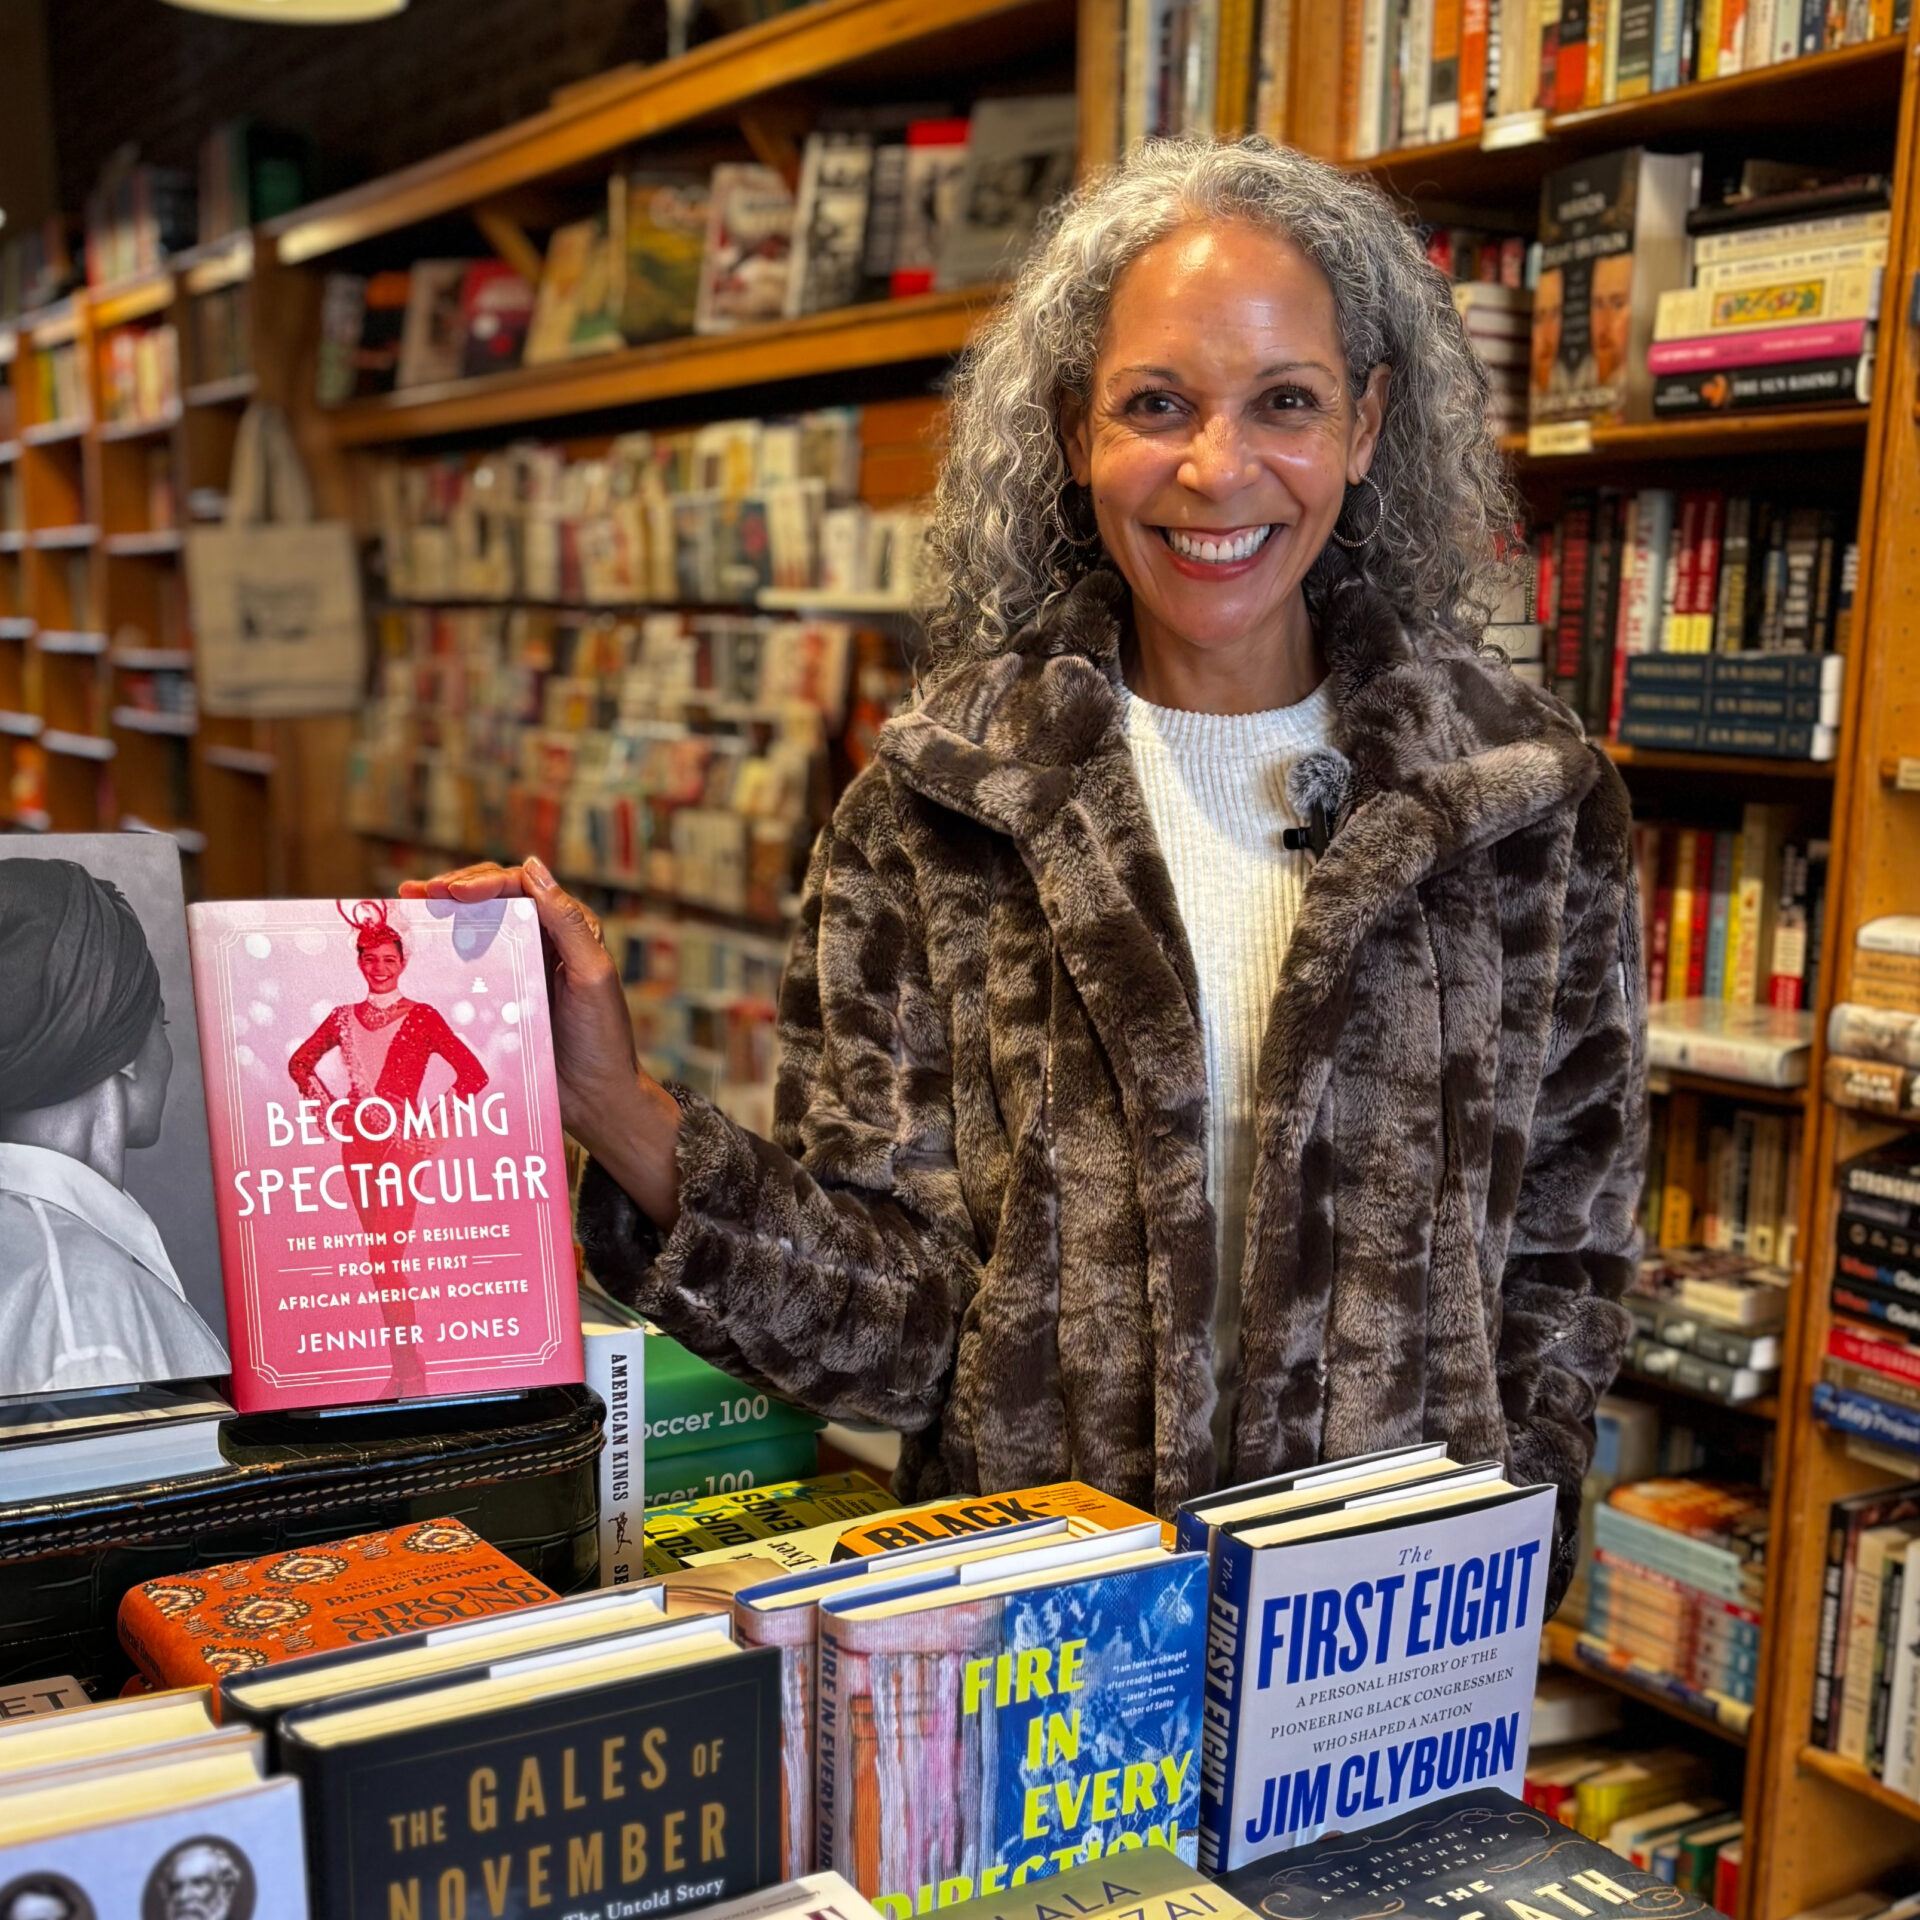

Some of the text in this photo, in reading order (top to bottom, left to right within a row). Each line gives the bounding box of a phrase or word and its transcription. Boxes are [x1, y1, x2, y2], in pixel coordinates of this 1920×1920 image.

[267, 1092, 509, 1147] BECOMING
[234, 1155, 549, 1216] SPECTACULAR
[287, 1224, 510, 1251] THE RHYTHM OF RESILIENCE
[338, 1255, 468, 1277] FROM THE FIRST
[278, 1279, 529, 1311] AFRICAN AMERICAN ROCKETTE
[297, 1317, 520, 1354] JENNIFER JONES
[611, 1354, 629, 1501] AMERICAN KINGS
[644, 1395, 769, 1440] occer 100
[704, 1469, 755, 1494] 100
[693, 1511, 757, 1546] OUR
[766, 1541, 820, 1567] Ever
[1398, 1545, 1433, 1567] The
[324, 1562, 501, 1607] Brené Brown
[332, 1576, 539, 1631] STRONG
[348, 1588, 551, 1642] GROUND
[1257, 1539, 1541, 1690] FIRST EIGHT
[820, 1631, 838, 1689] FIRE
[963, 1638, 1087, 1716] FIRE
[1132, 1658, 1159, 1670] forever
[1153, 1669, 1167, 1681] this
[1201, 1556, 1239, 1806] The FIRST EIGHT
[1295, 1647, 1499, 1709] A PERSONAL HISTORY OF THE
[0, 1688, 69, 1719] ET
[820, 1695, 836, 1727] IN
[1270, 1666, 1515, 1740] PIONEERING BLACK CONGRESSMEN
[1312, 1702, 1474, 1754] WHO SHAPED A NATION
[1026, 1709, 1080, 1771] IN
[389, 1727, 724, 1851] THE GALES OF
[820, 1731, 836, 1819] EVERY
[1022, 1749, 1193, 1840] EVERY
[1245, 1711, 1520, 1844] JIM CLYBURN
[388, 1801, 727, 1920] NOVEMBER
[1318, 1827, 1475, 1885] THE HISTORY
[1320, 1832, 1511, 1903] AND FUTURE OF
[1367, 1851, 1487, 1897] THE WIND
[606, 1889, 670, 1920] Untold
[676, 1876, 725, 1903] Story
[1035, 1880, 1143, 1920] ALA
[1118, 1892, 1219, 1920] ZAI
[1424, 1879, 1495, 1908] THE
